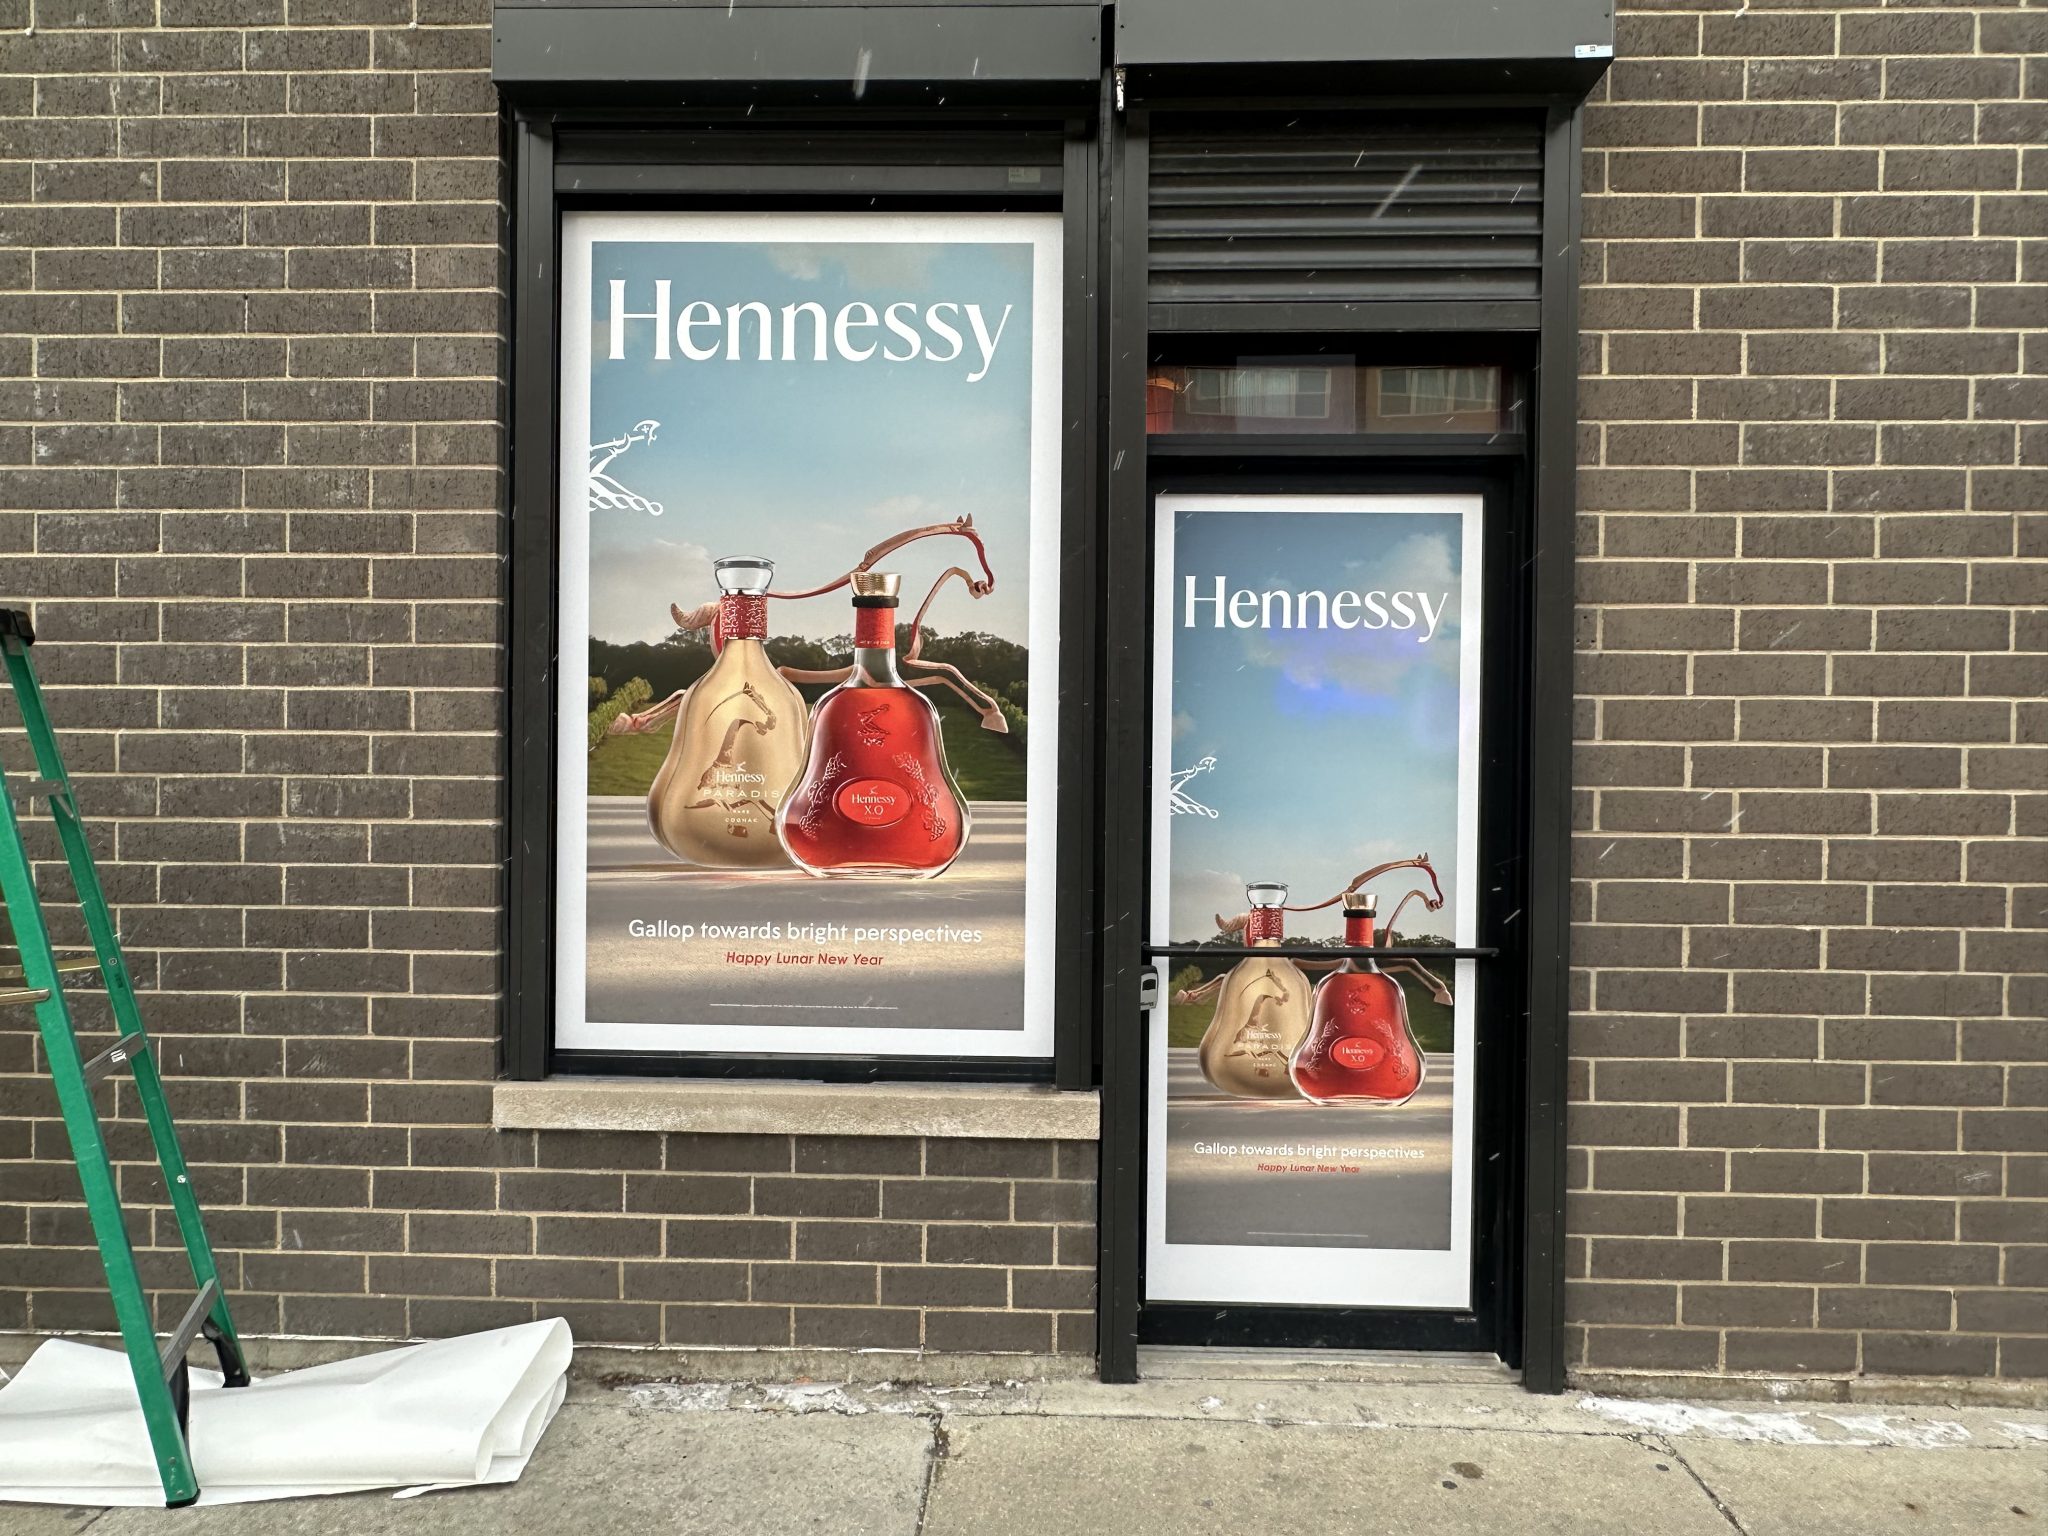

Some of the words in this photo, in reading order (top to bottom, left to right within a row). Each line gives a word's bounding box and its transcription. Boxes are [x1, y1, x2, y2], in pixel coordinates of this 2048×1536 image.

[608, 278, 1013, 383] Hennessy
[1184, 575, 1449, 643] Hennessy
[716, 770, 766, 785] Hennessy
[703, 789, 780, 798] PARADIS
[851, 793, 896, 806] Hennessy
[628, 919, 695, 943] Gallop
[700, 921, 781, 940] towards
[787, 921, 848, 945] bright
[854, 924, 983, 946] perspectives
[726, 951, 772, 966] Happy
[776, 952, 814, 965] Lunar
[818, 953, 848, 966] New
[853, 954, 884, 966] Year
[1194, 1142, 1238, 1158] Gallop
[1241, 1143, 1294, 1156] towards
[1297, 1144, 1338, 1159] bright
[1341, 1147, 1425, 1160] perspectives
[1257, 1163, 1288, 1174] Happy
[1290, 1164, 1315, 1173] Lunar
[1316, 1165, 1338, 1173] New
[1340, 1165, 1361, 1174] Year
